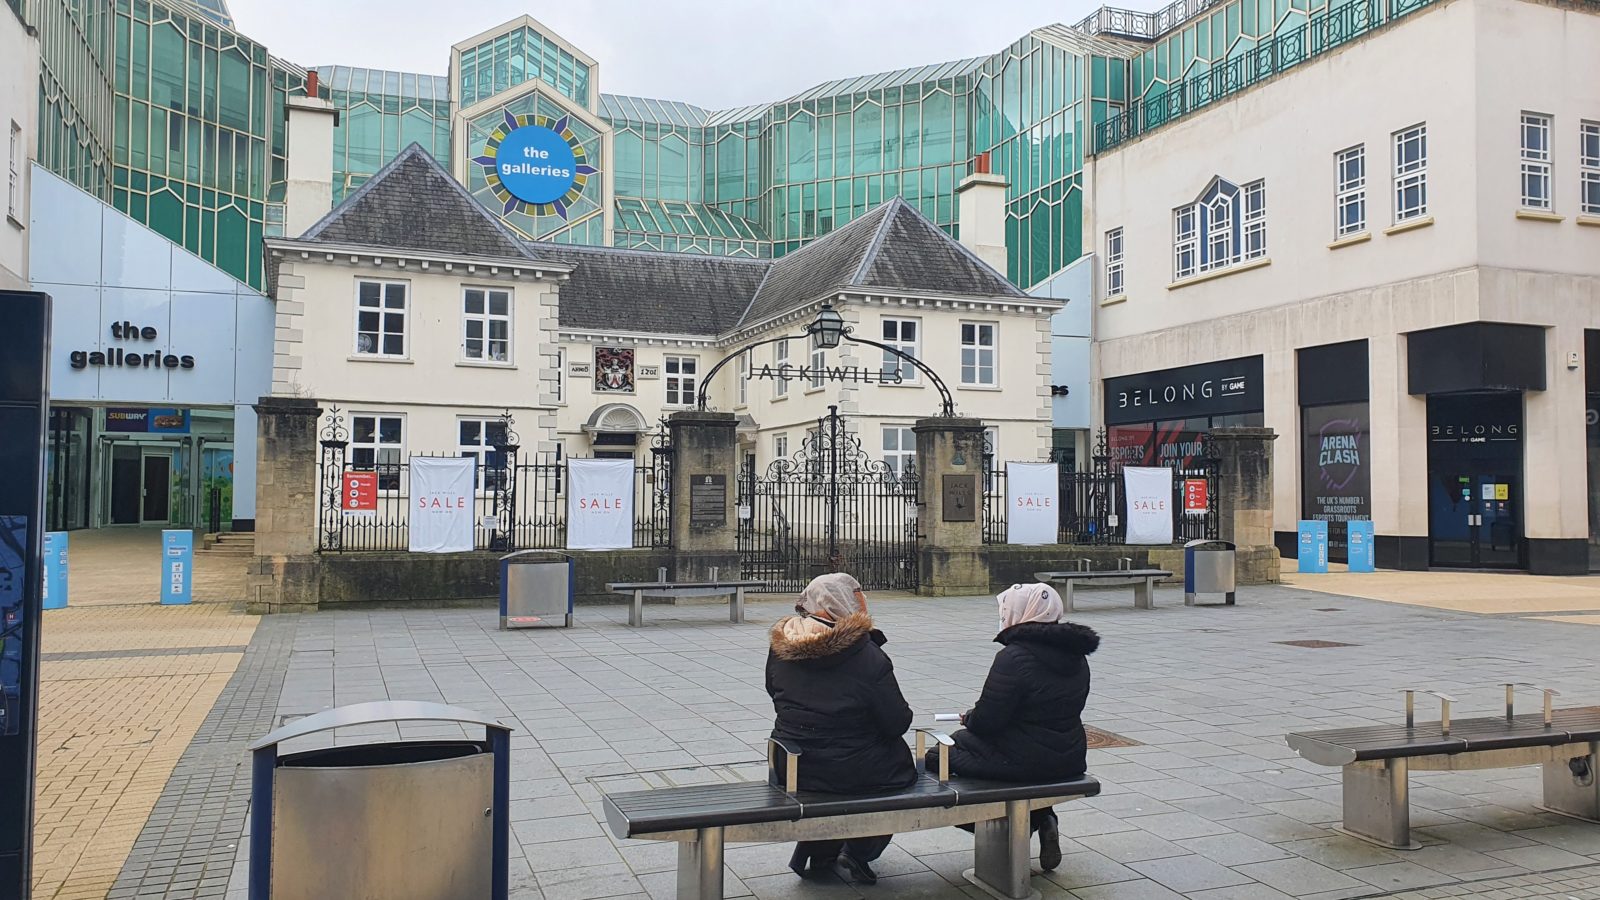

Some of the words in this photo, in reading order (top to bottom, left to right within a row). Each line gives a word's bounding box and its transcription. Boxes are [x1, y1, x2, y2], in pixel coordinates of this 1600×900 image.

[523, 146, 549, 159] the
[502, 163, 570, 178] galleries
[111, 321, 157, 340] the
[70, 347, 194, 369] galleries
[746, 363, 812, 382] JACK
[826, 366, 903, 385] WILLS
[1119, 381, 1212, 407] BELONG
[1229, 381, 1245, 390] GAME
[108, 412, 147, 420] SUBWAY
[1432, 425, 1517, 435] BELONG
[1160, 442, 1177, 458] JOIN
[1180, 441, 1203, 457] YOUR
[1321, 435, 1357, 451] ARENA
[1319, 449, 1360, 467] CLASH
[419, 497, 464, 508] SALE
[580, 498, 621, 509] SALE
[1017, 497, 1050, 507] SALE
[1134, 500, 1164, 510] SALE
[1316, 496, 1326, 505] THE
[1326, 496, 1338, 505] UK'S
[1339, 496, 1360, 505] NUMBER
[1323, 505, 1357, 514] GRASSROOTS
